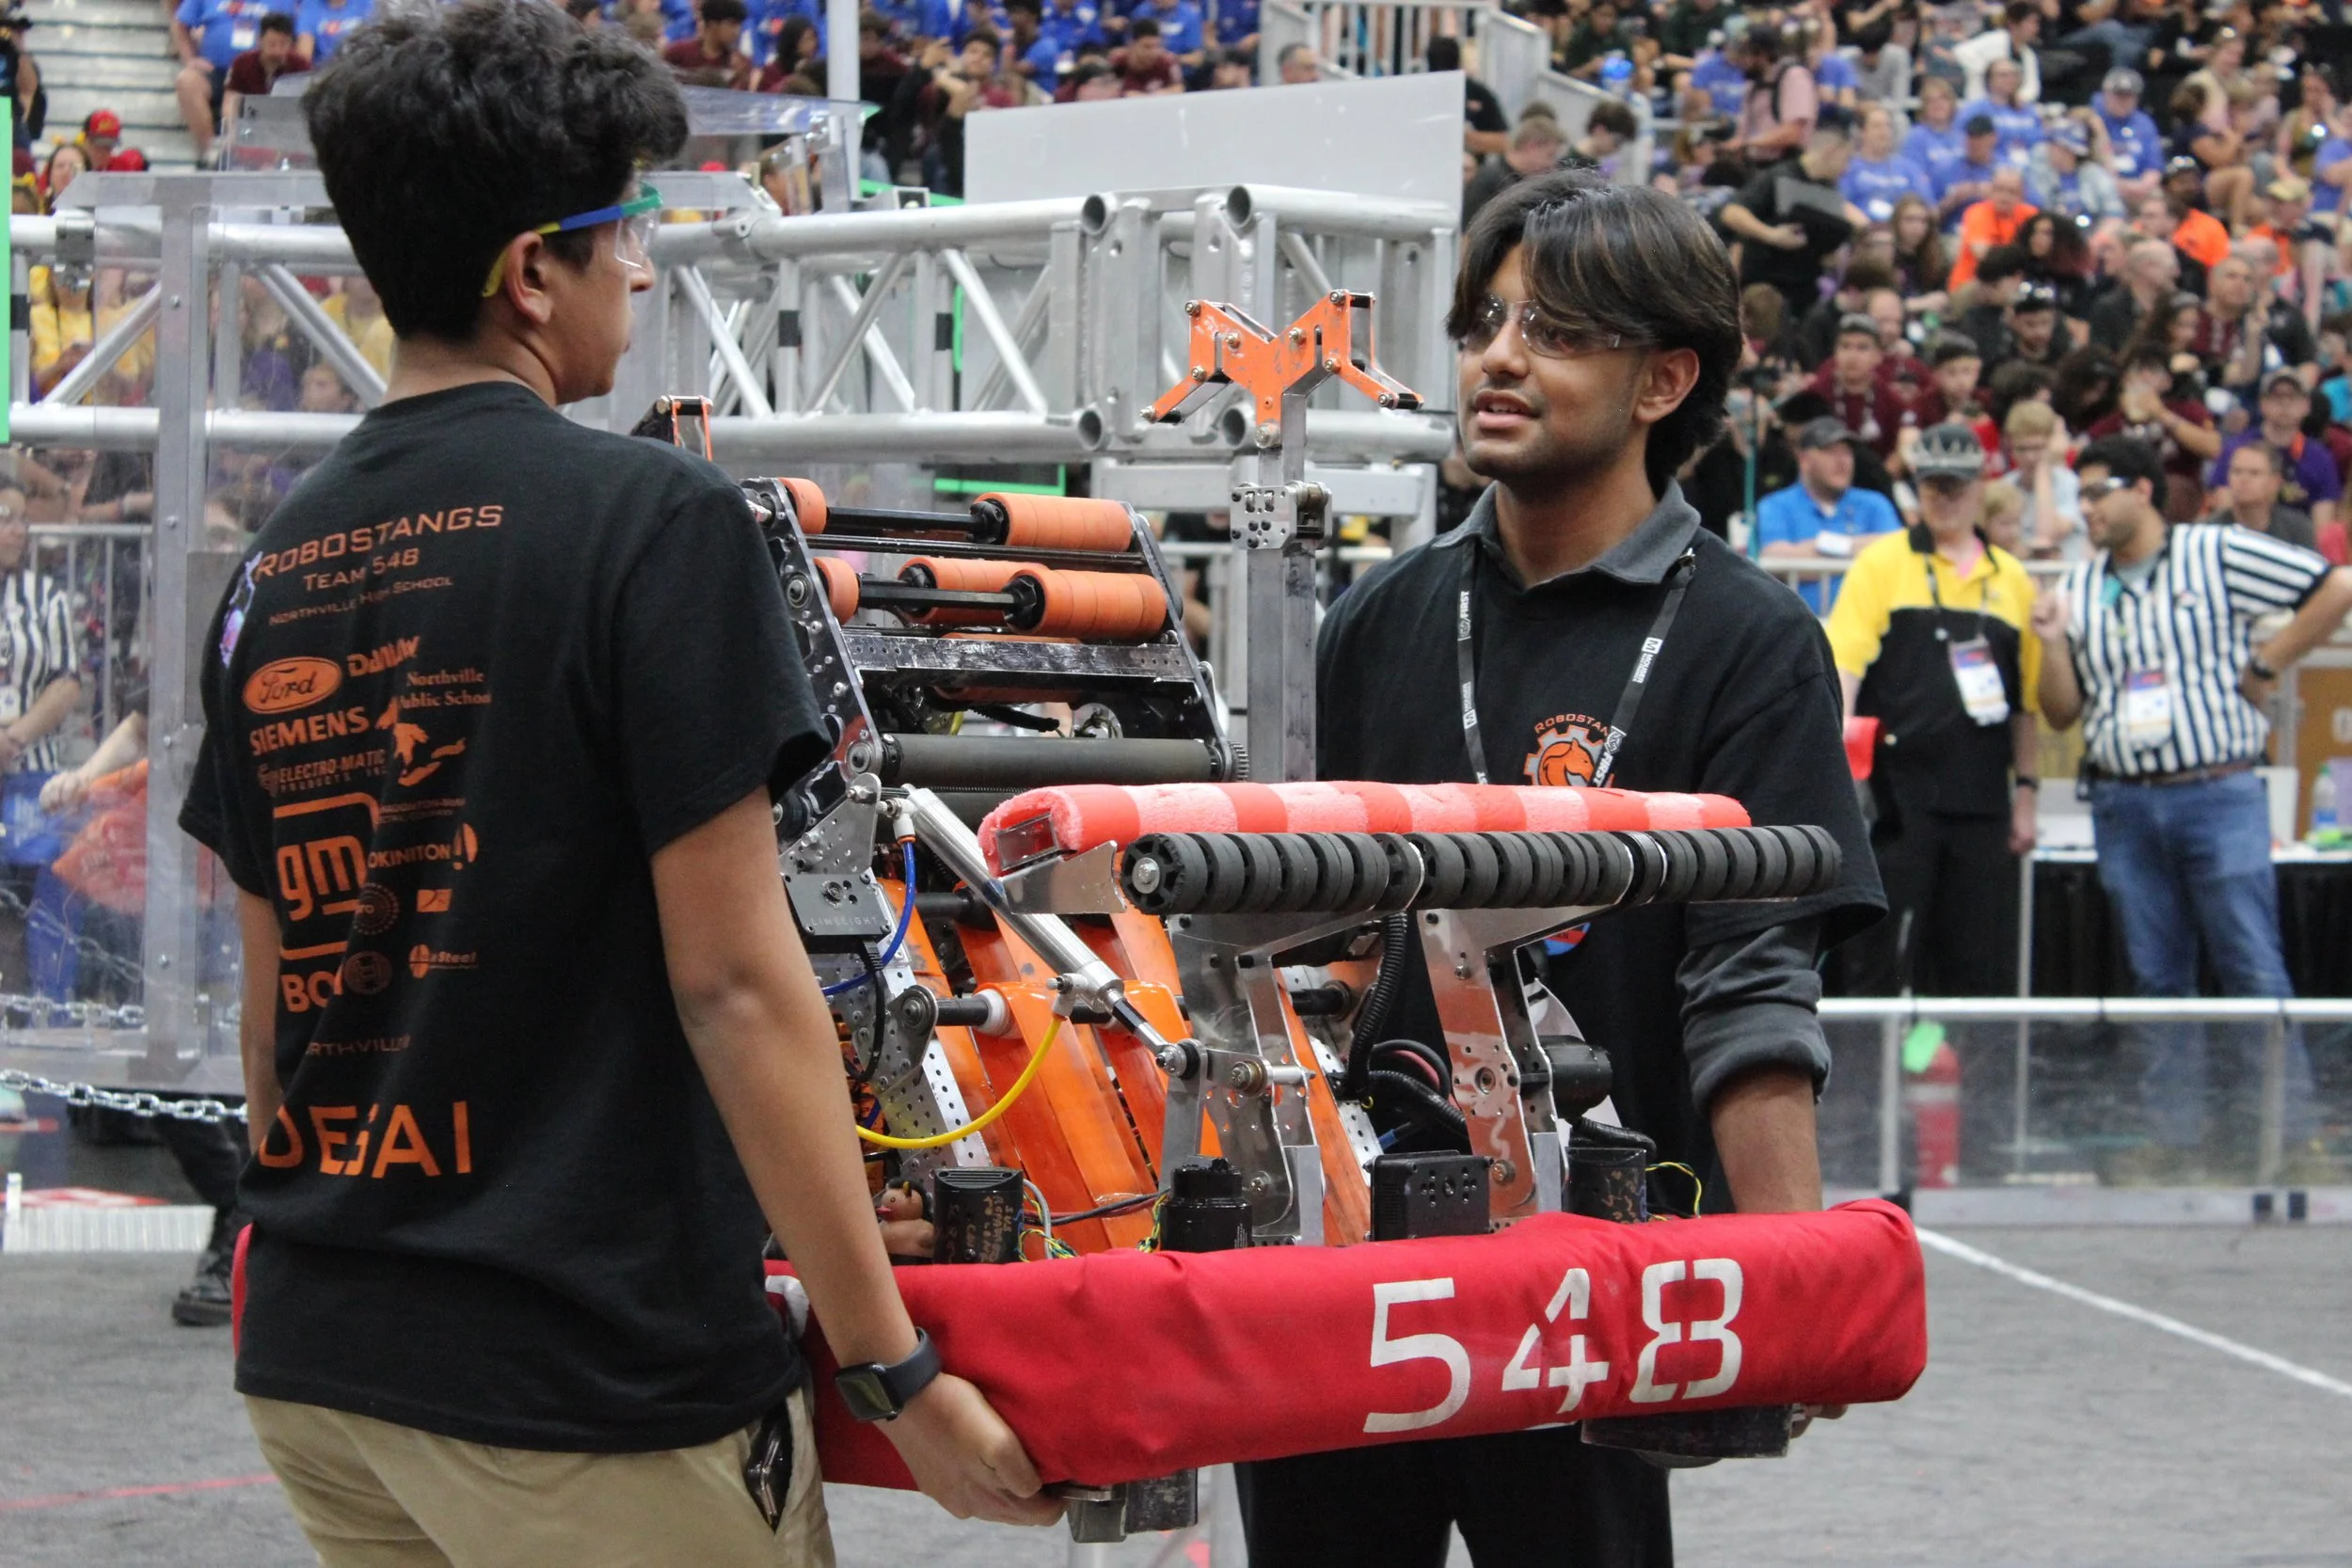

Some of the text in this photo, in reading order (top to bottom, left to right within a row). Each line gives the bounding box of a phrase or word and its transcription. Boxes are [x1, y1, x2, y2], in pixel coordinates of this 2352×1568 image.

[254, 505, 504, 582] ROBOSTANGS
[303, 548, 420, 591] TEAM 548
[260, 667, 318, 704] Ford
[249, 706, 370, 756] SIEMENS
[1534, 713, 1608, 736] ROBOSTAN
[278, 834, 368, 922] gm
[1363, 1258, 1742, 1433] 548
